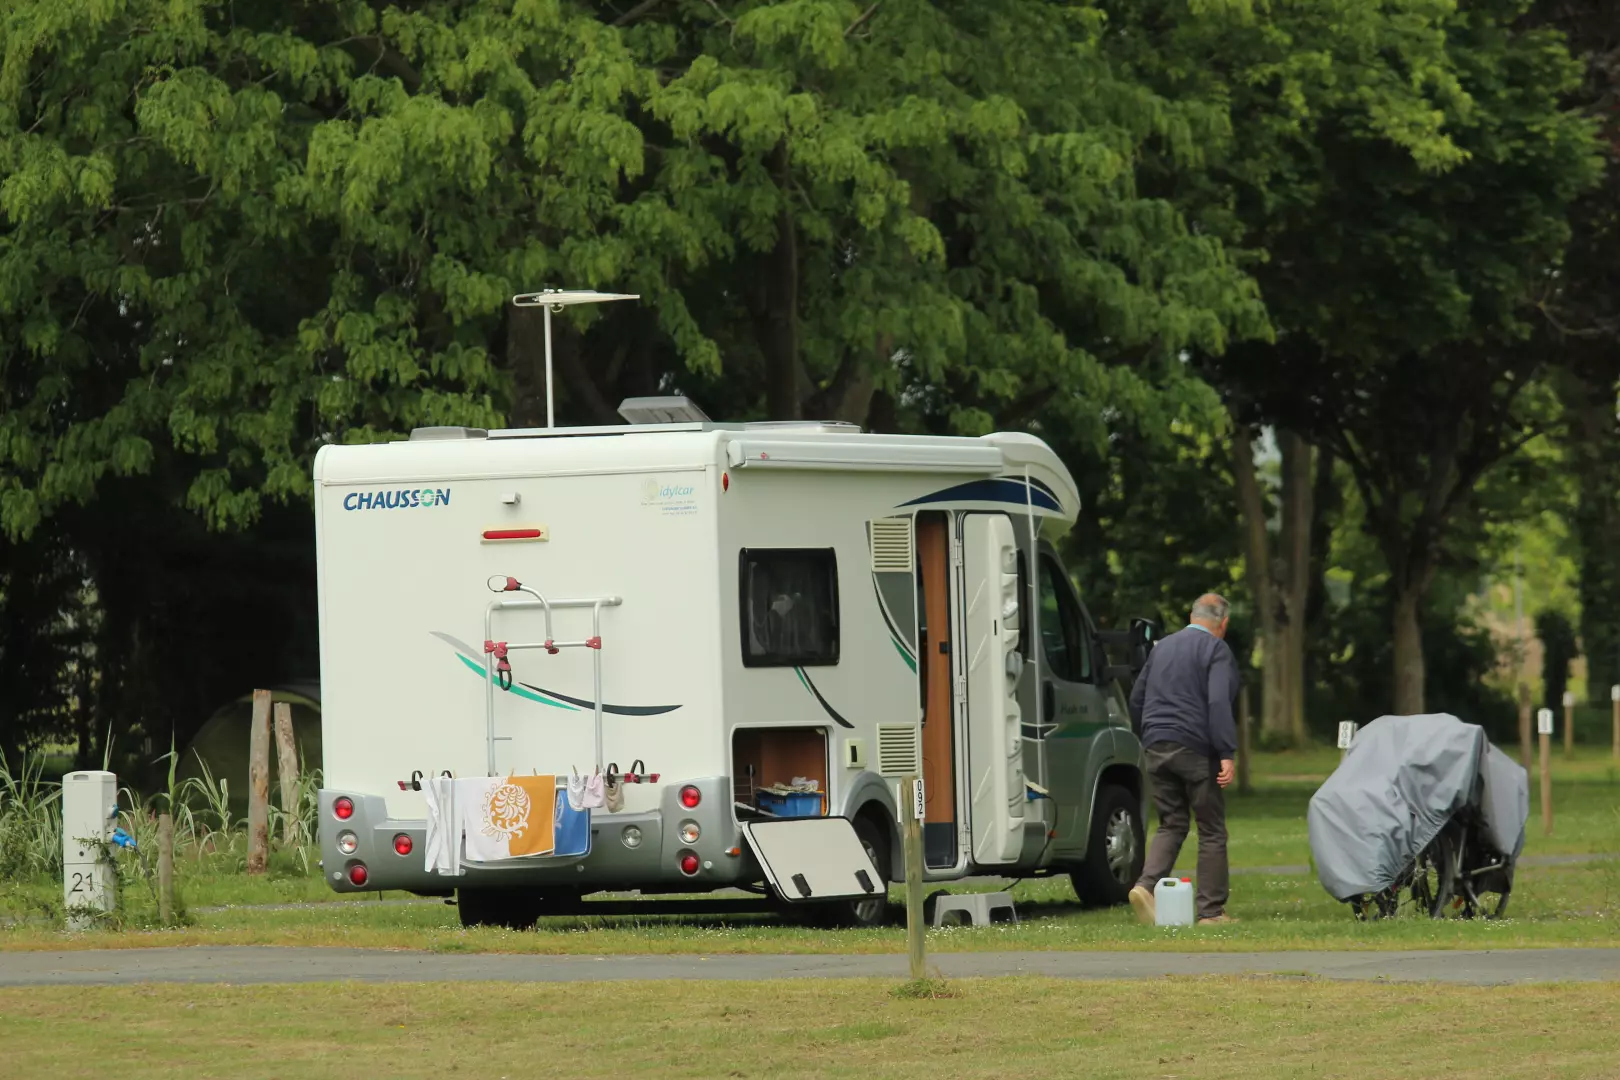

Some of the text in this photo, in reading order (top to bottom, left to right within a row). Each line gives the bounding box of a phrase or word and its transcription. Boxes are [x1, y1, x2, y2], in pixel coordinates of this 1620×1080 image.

[343, 489, 451, 511] CHAUSSON
[660, 485, 694, 499] idylcar
[72, 872, 93, 892] 21
